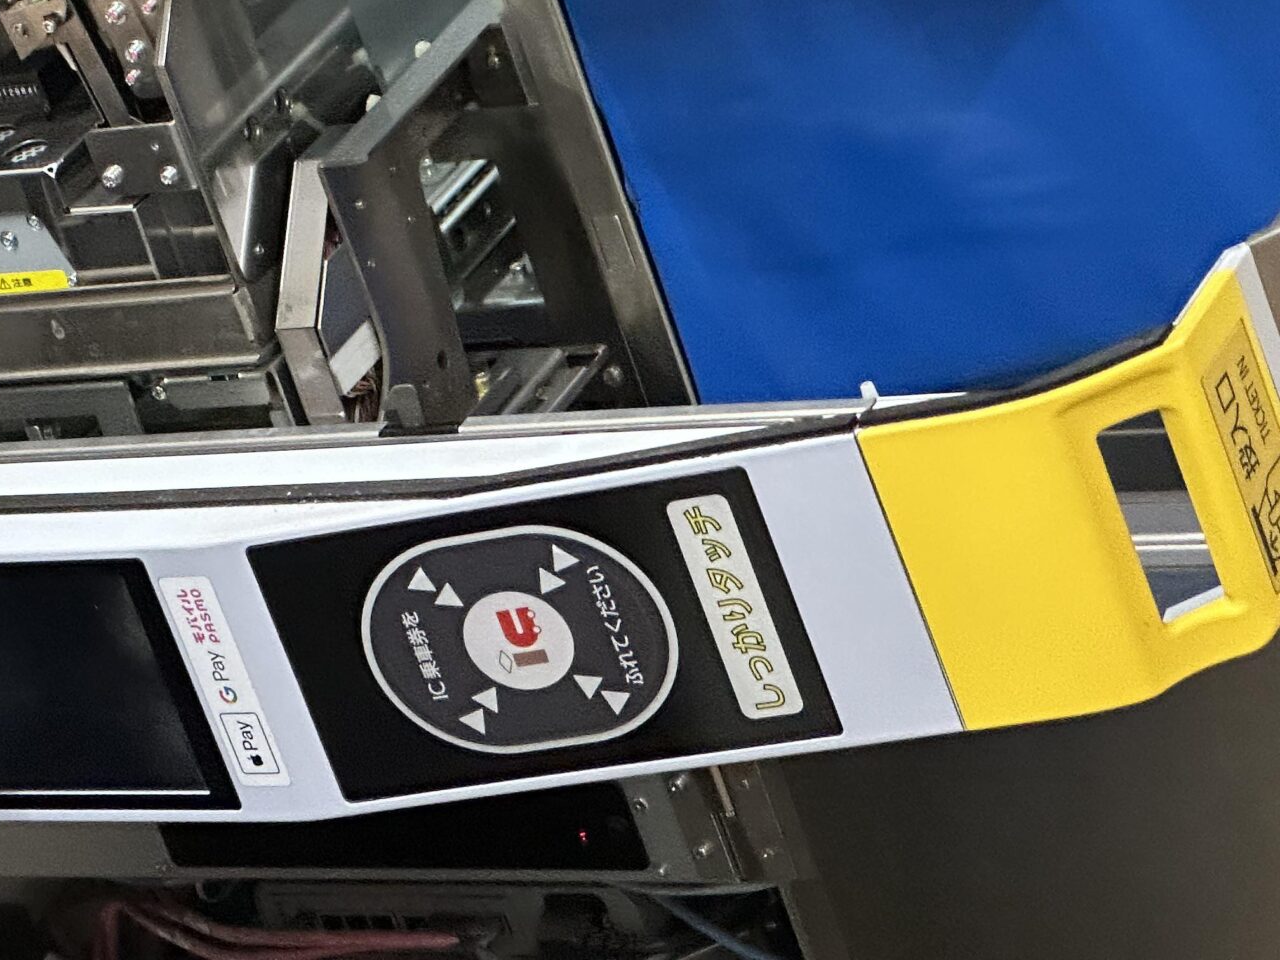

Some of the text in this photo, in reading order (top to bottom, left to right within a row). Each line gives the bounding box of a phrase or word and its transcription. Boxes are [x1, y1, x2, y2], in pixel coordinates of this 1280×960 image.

[11, 277, 32, 288] 注意
[1215, 371, 1261, 481] 投入口
[1236, 354, 1271, 445] TICKET IN
[176, 588, 205, 645] モバイル
[586, 565, 644, 686] ふれてください
[683, 505, 786, 710] しっかりタッチ
[207, 650, 230, 682] Pay
[236, 720, 259, 751] Pay
